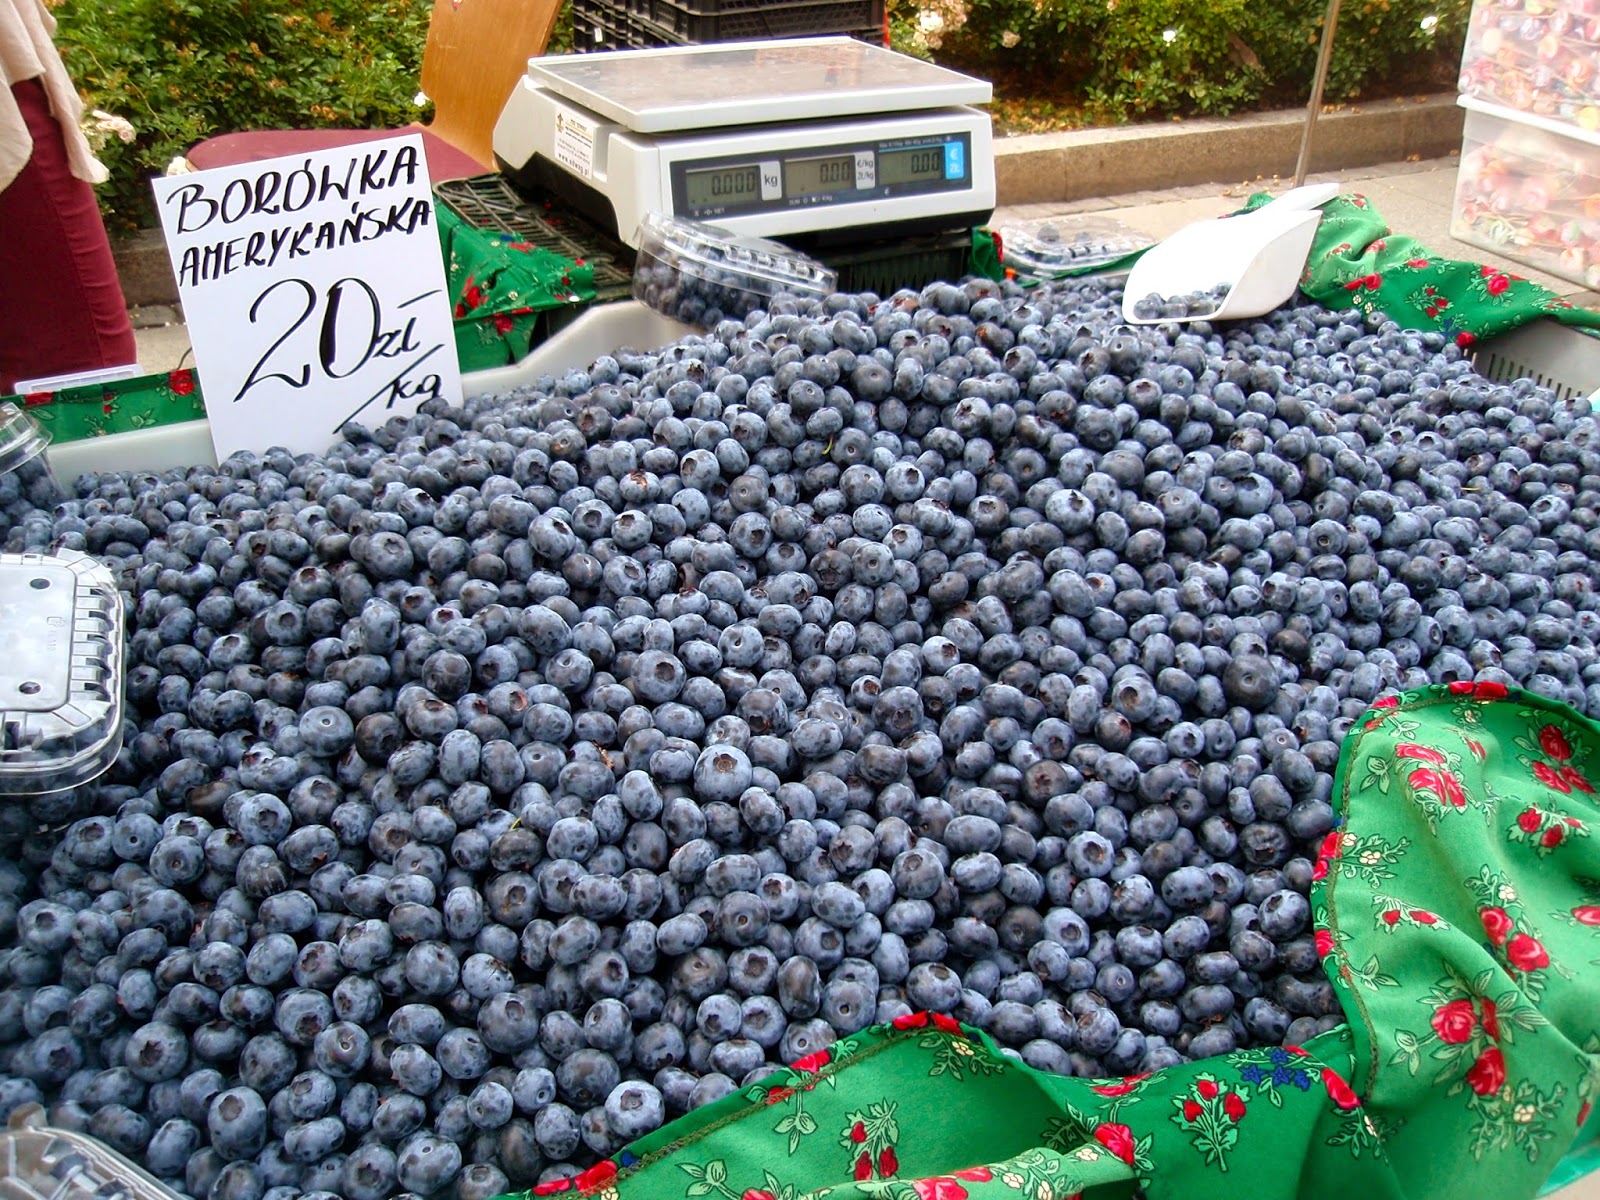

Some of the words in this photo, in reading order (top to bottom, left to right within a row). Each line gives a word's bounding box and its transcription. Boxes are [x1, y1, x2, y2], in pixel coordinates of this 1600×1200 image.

[166, 146, 420, 234] BORÓWKA
[712, 171, 755, 196] 0.000
[764, 174, 778, 187] kg
[179, 198, 433, 287] AMERYKAŃSKA
